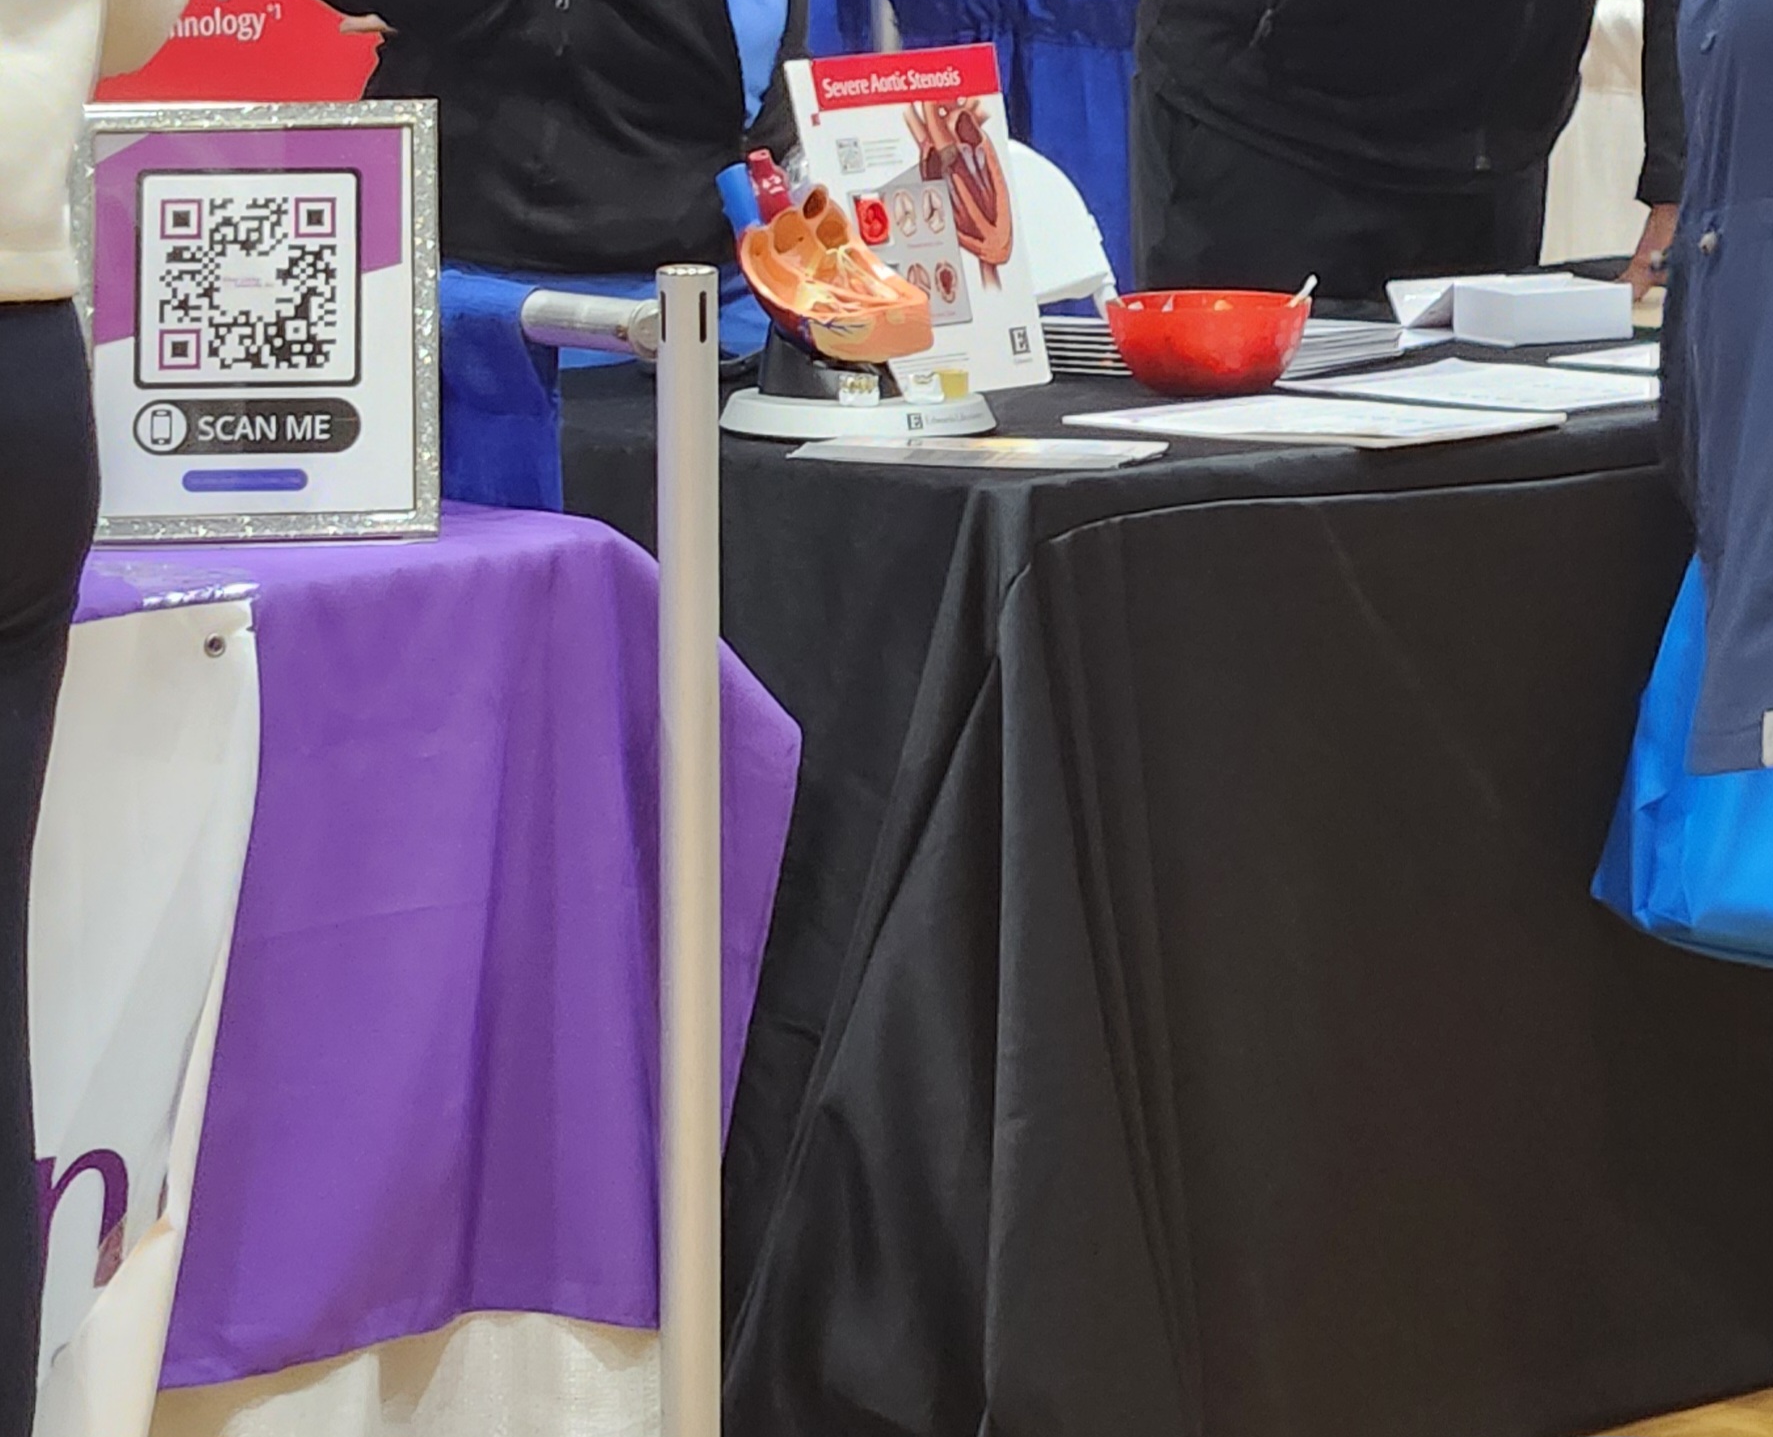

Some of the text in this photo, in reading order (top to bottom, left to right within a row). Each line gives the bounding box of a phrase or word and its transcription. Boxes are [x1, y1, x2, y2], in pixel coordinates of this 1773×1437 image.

[822, 66, 961, 99] Severe Aortic Stenosis
[198, 414, 331, 442] SCAN ME
